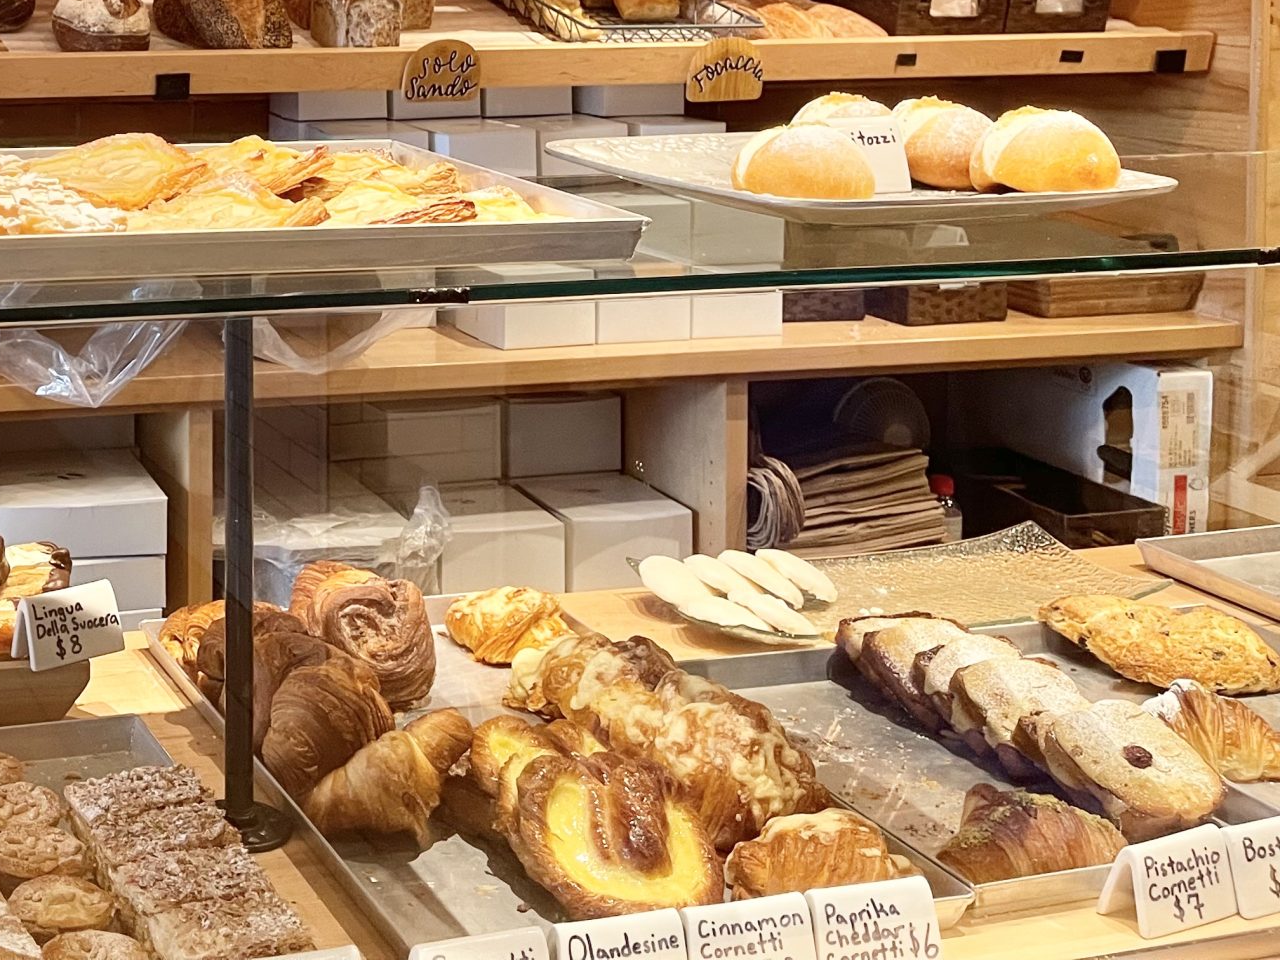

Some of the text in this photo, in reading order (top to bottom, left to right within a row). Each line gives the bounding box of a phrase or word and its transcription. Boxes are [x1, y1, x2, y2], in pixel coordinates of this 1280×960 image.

[418, 50, 476, 79] Solo
[692, 55, 763, 93] Focaccia
[405, 75, 477, 99] Sando
[32, 602, 83, 622] Lingua
[36, 613, 120, 639] Della Suocera
[1144, 847, 1220, 878] Pistachio
[1149, 866, 1220, 902] Cornetti
[825, 897, 900, 930] Paprika
[1174, 893, 1204, 922] $7
[698, 909, 804, 938] Cinnamon
[568, 931, 680, 960] Olandesine
[700, 933, 784, 960] Cornetti
